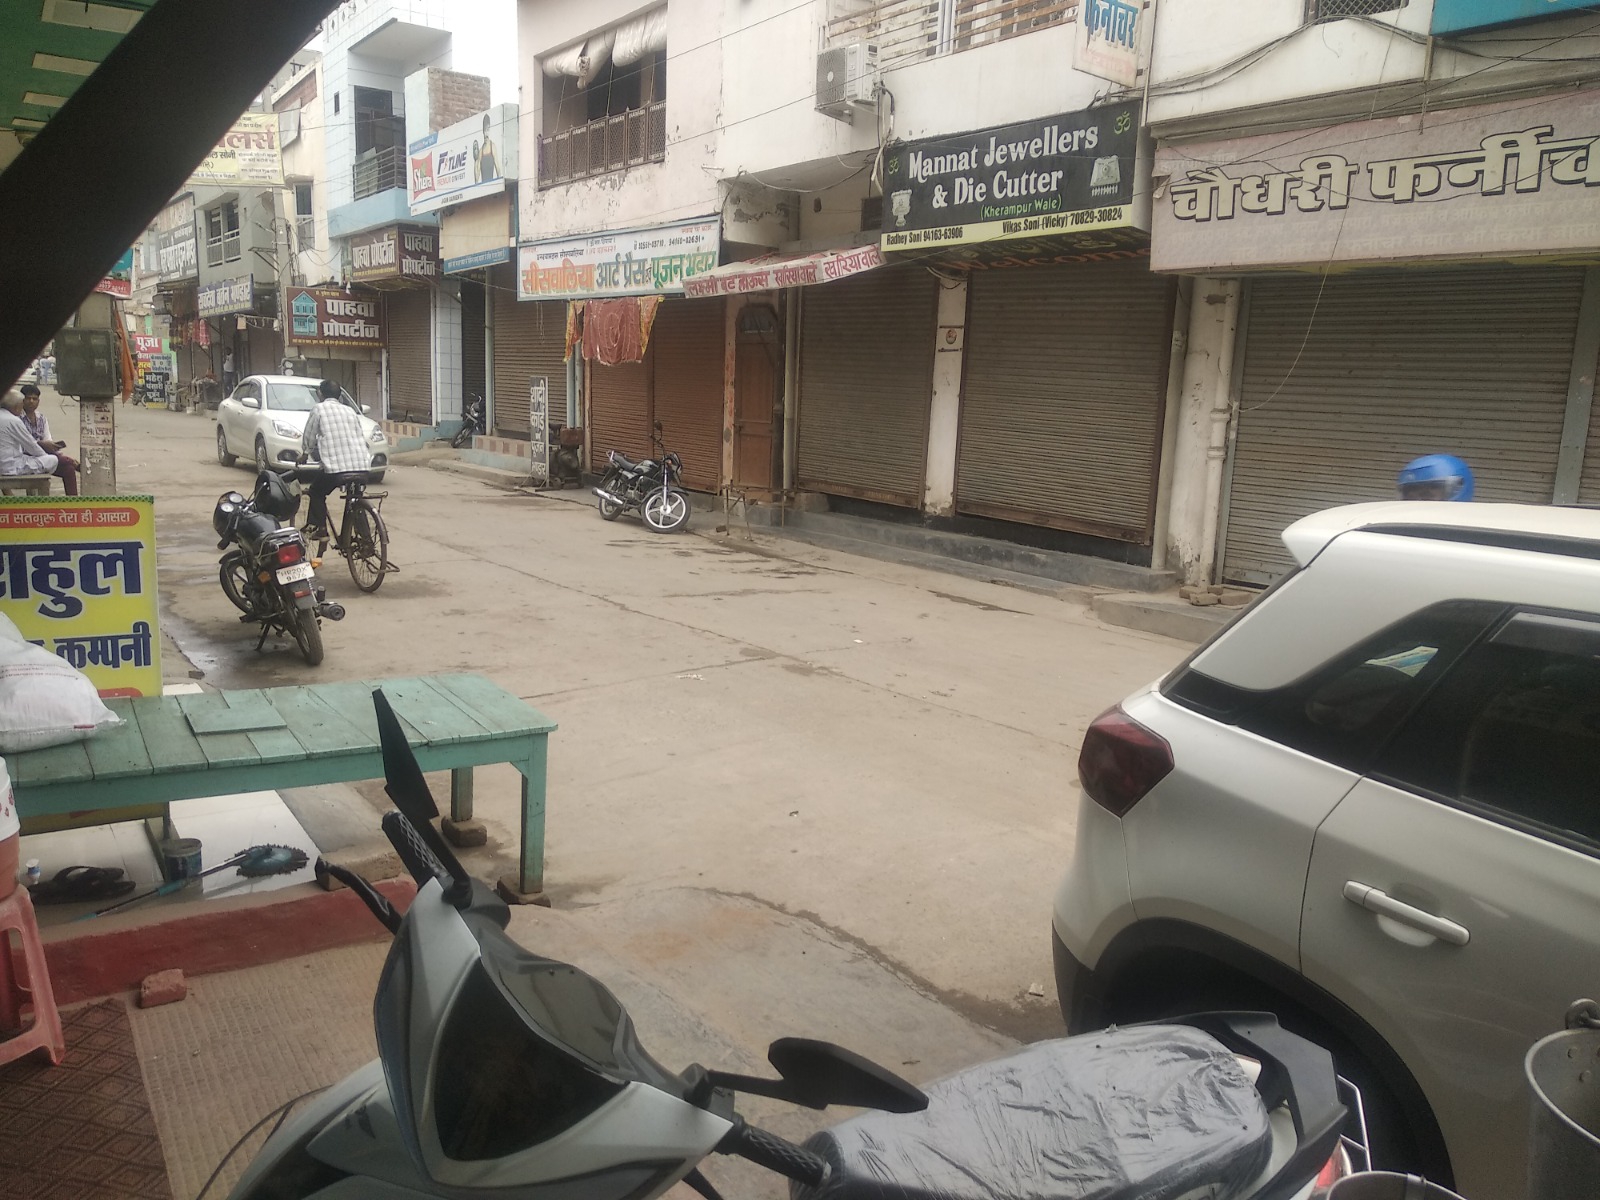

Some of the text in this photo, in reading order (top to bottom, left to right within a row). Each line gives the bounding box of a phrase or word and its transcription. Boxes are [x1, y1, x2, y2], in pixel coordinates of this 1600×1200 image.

[908, 125, 1099, 183] Mannat Jewellers
[413, 168, 432, 192] Shera
[932, 169, 1063, 209] & Die Cutter
[1170, 154, 1360, 222] चौधरी
[980, 194, 1062, 220] (Kherampur Wale)
[1002, 219, 1021, 233] Vikas
[1023, 216, 1040, 231] Soni
[1042, 214, 1068, 230] (Vicky)
[886, 232, 907, 245] Radhey
[909, 231, 922, 243] Soni
[522, 257, 597, 295] सीसवालिया
[596, 252, 623, 287] आर्ट
[651, 253, 684, 289] पूजन
[325, 299, 375, 318] पाहवा
[136, 336, 159, 351] पूजा
[58, 509, 78, 524] तेरा
[81, 509, 93, 524] ही
[96, 511, 130, 523] आसरा
